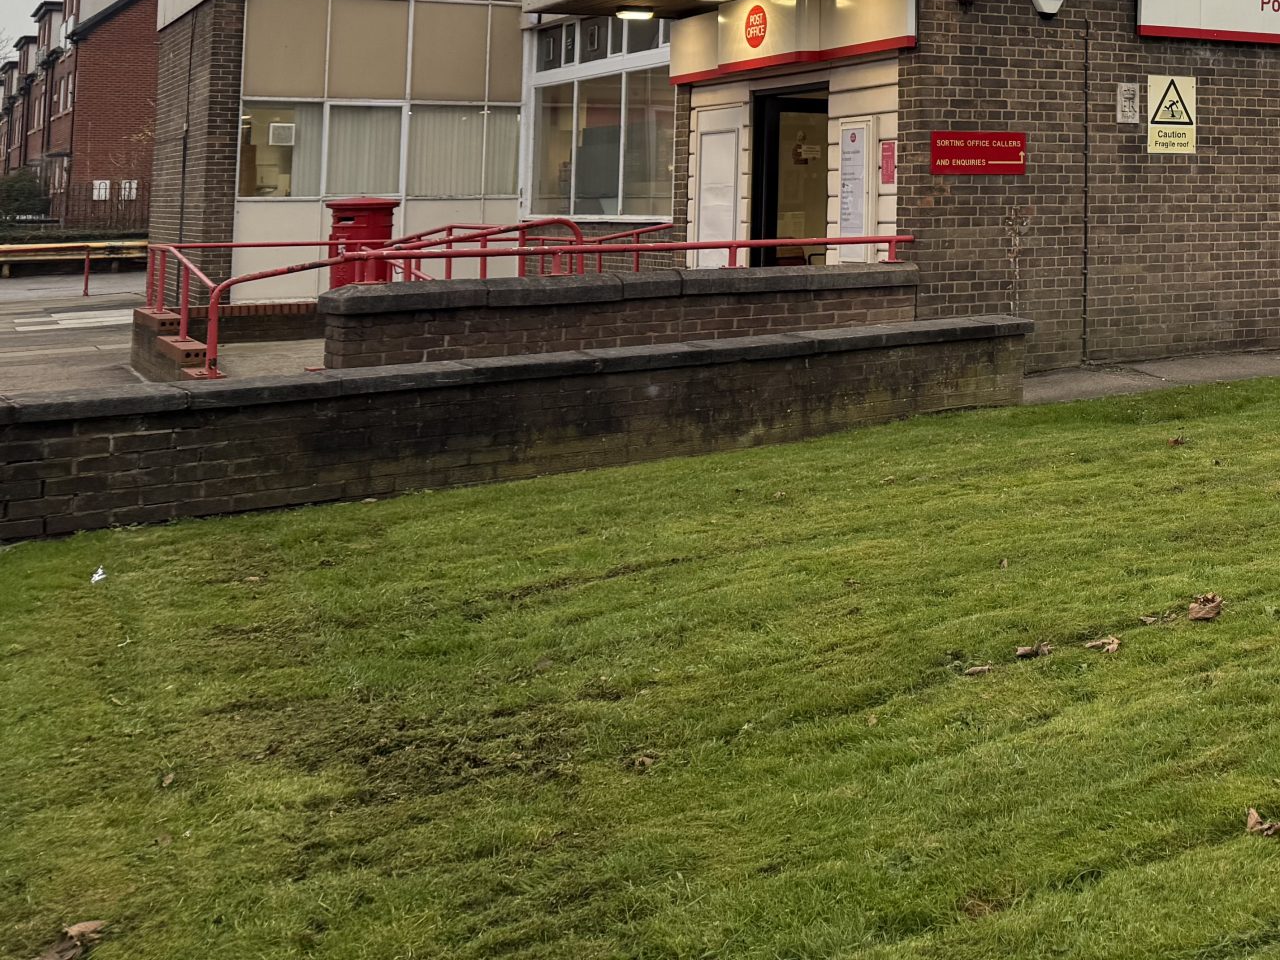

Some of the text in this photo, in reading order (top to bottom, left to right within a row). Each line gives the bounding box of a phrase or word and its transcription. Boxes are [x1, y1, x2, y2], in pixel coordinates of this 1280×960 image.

[750, 13, 763, 26] POST
[747, 25, 765, 38] OFFICE
[1157, 130, 1187, 139] Caution
[936, 139, 965, 147] SORTING
[992, 140, 1021, 148] CALLERS
[1154, 141, 1176, 149] Fragile
[936, 158, 950, 166] AND
